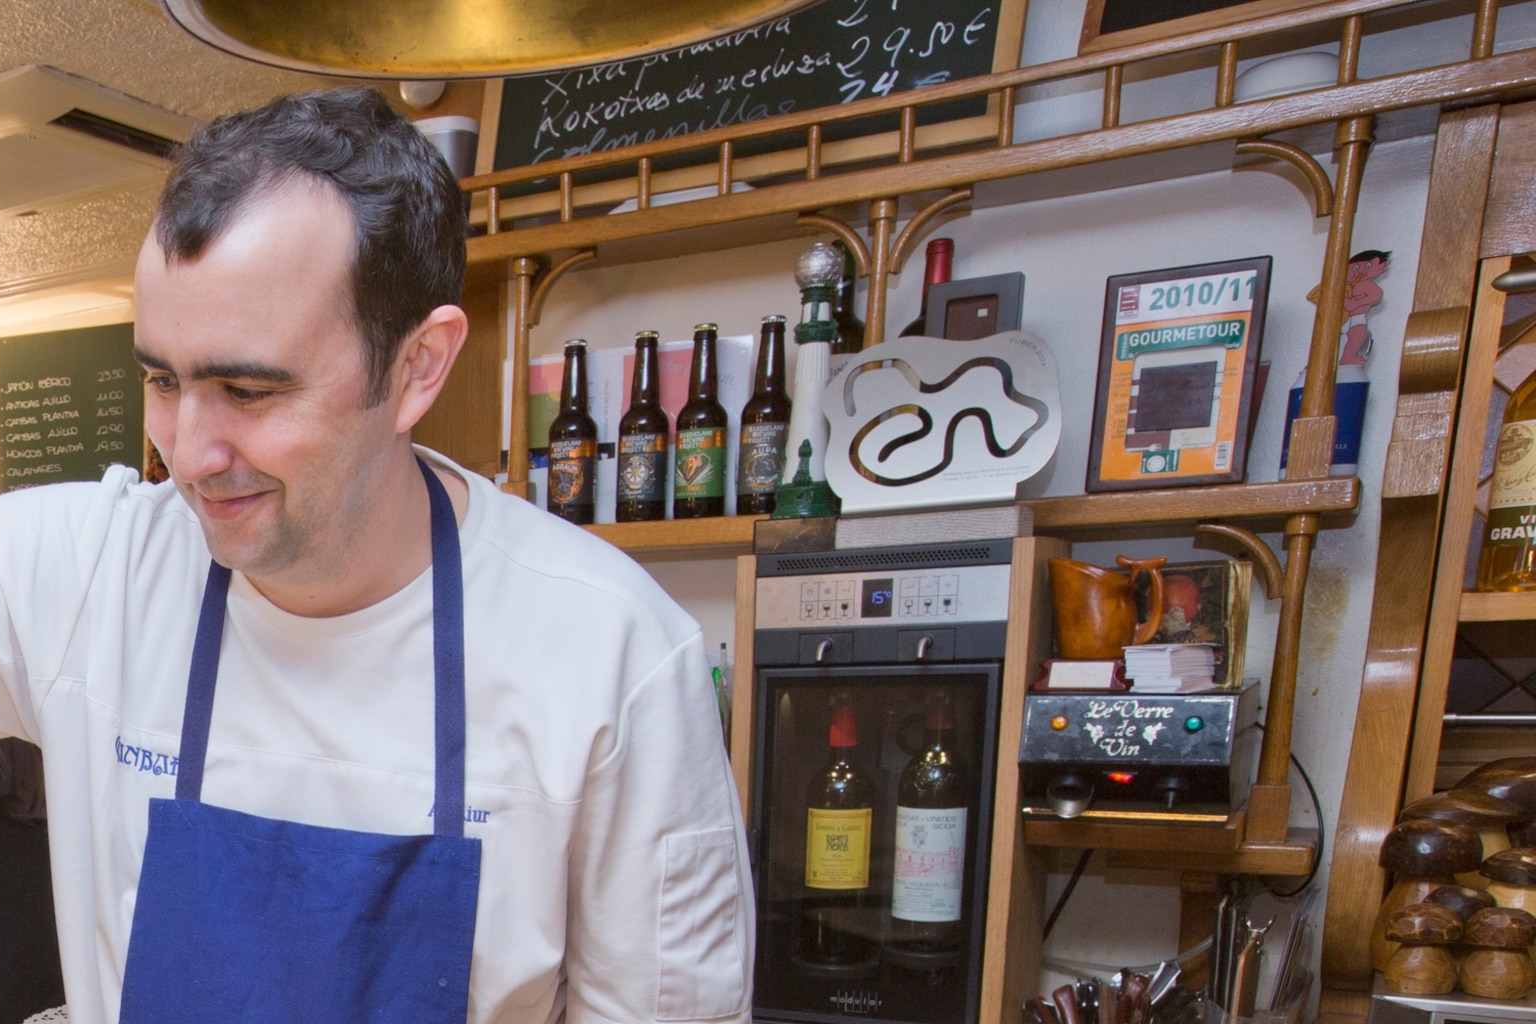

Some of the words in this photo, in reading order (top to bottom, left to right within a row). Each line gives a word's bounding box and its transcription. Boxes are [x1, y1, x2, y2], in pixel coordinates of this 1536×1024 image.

[1149, 276, 1256, 311] 2010/11
[1129, 322, 1241, 347] GOURMETOUR
[752, 446, 777, 455] AUPA
[1084, 700, 1114, 718] Le
[1113, 700, 1174, 718] Verre
[1114, 719, 1137, 737] de
[1099, 738, 1140, 756] Vin
